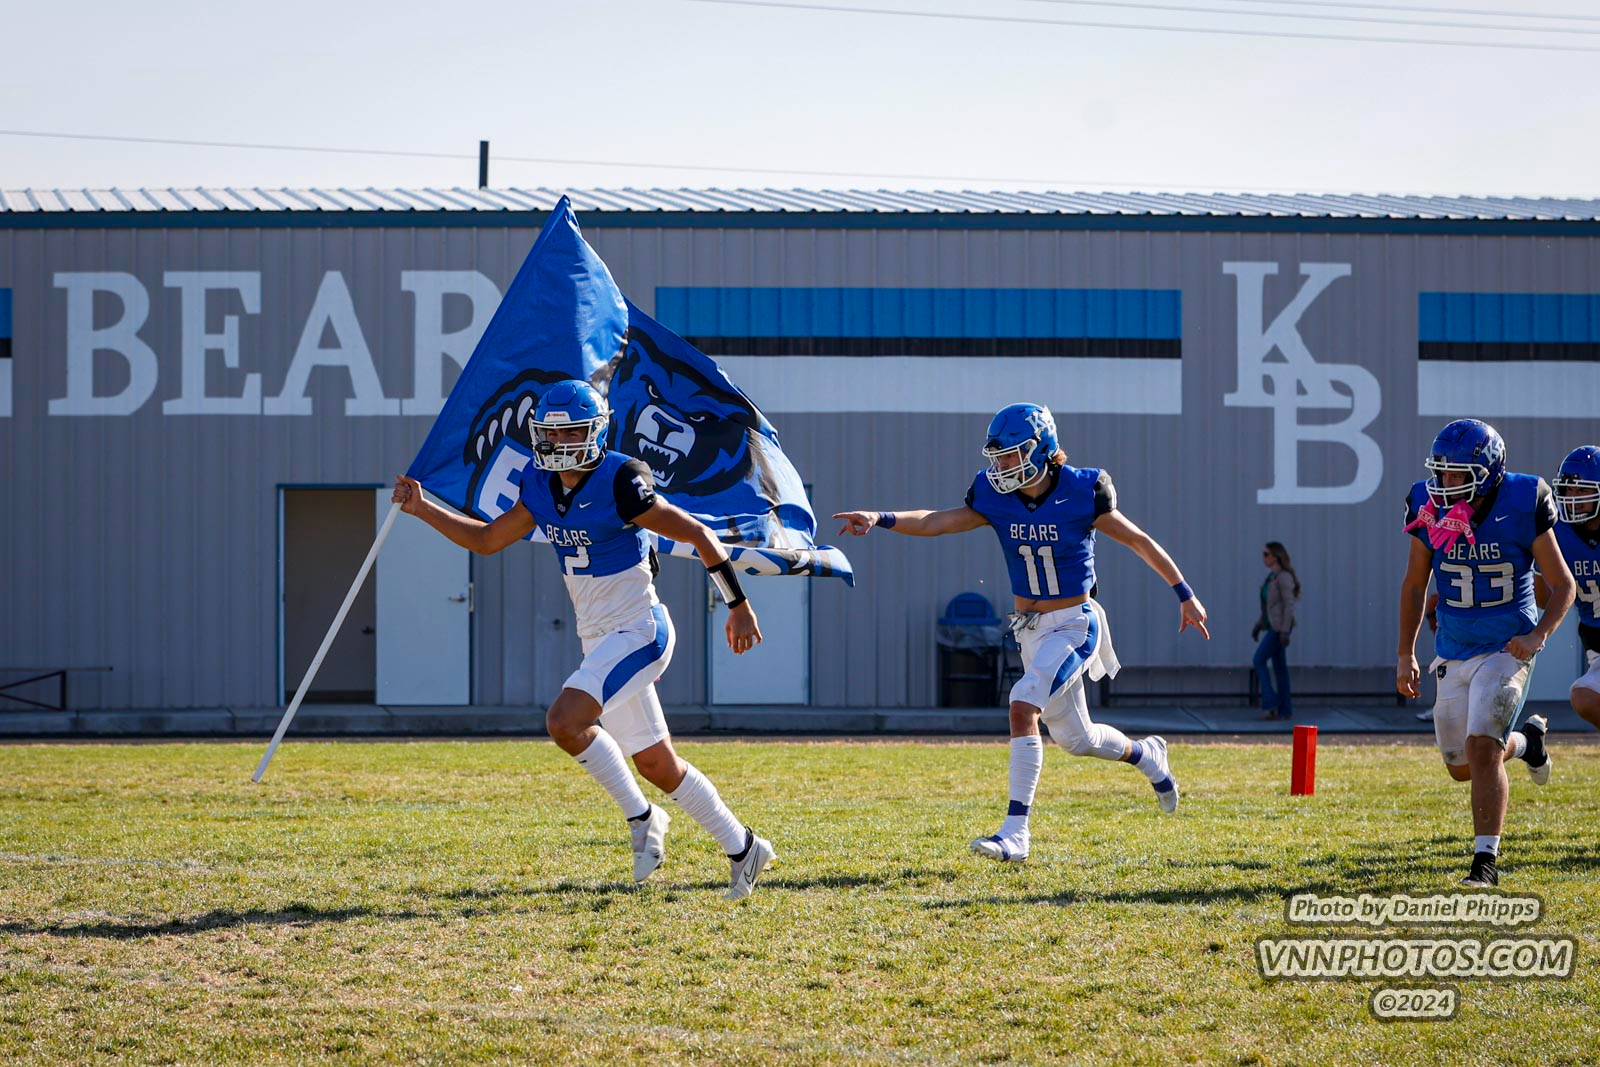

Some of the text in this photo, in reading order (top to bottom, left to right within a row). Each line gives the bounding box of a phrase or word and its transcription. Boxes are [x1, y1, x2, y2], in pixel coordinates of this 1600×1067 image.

[546, 524, 593, 546] BEARS
[1009, 523, 1059, 541] BEARS
[564, 545, 593, 577] 2
[1447, 542, 1501, 561] BEARS
[1018, 545, 1061, 596] 11
[1440, 561, 1515, 608] 33
